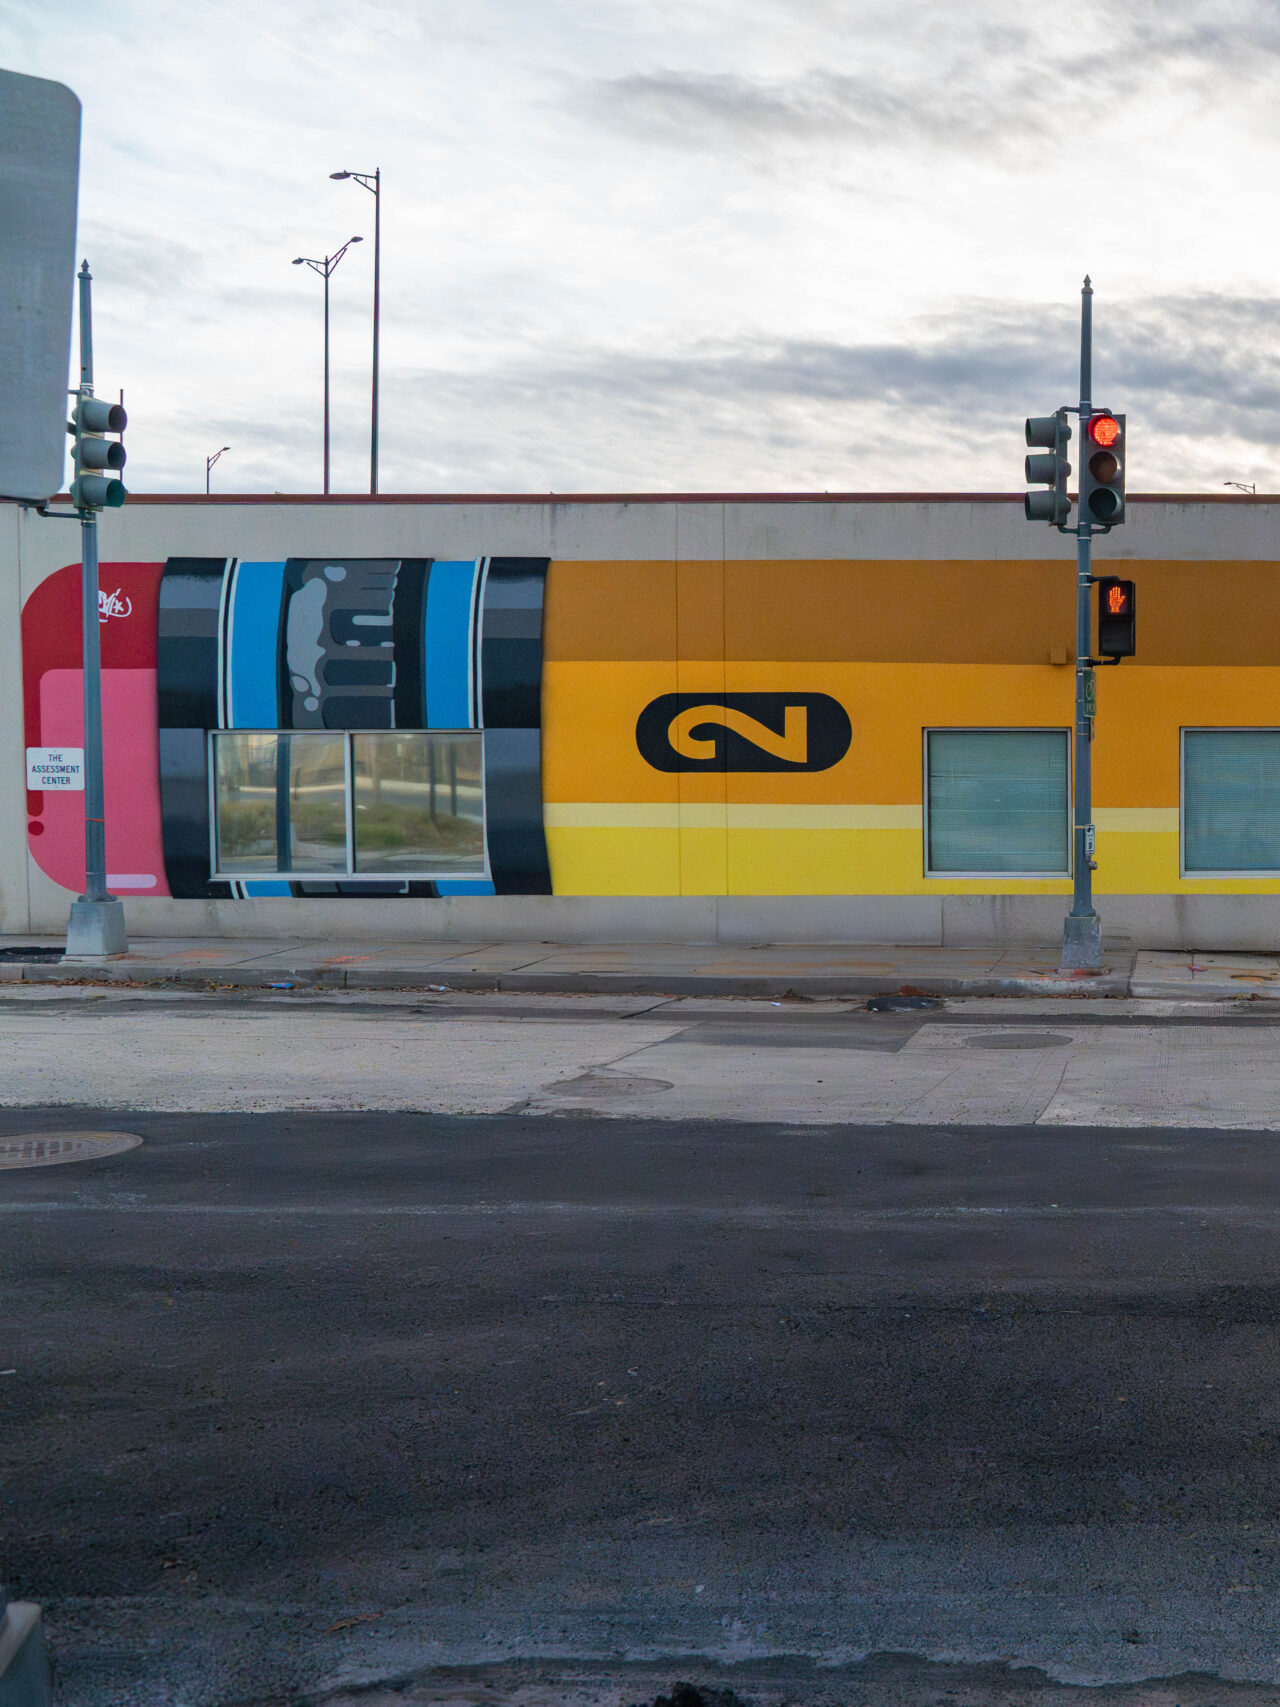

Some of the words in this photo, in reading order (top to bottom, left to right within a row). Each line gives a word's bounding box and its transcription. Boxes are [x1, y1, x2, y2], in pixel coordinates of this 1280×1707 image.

[667, 704, 808, 763] 2
[48, 753, 63, 762] THE
[31, 765, 80, 774] ASSESSMENT
[41, 776, 71, 785] CENTER
